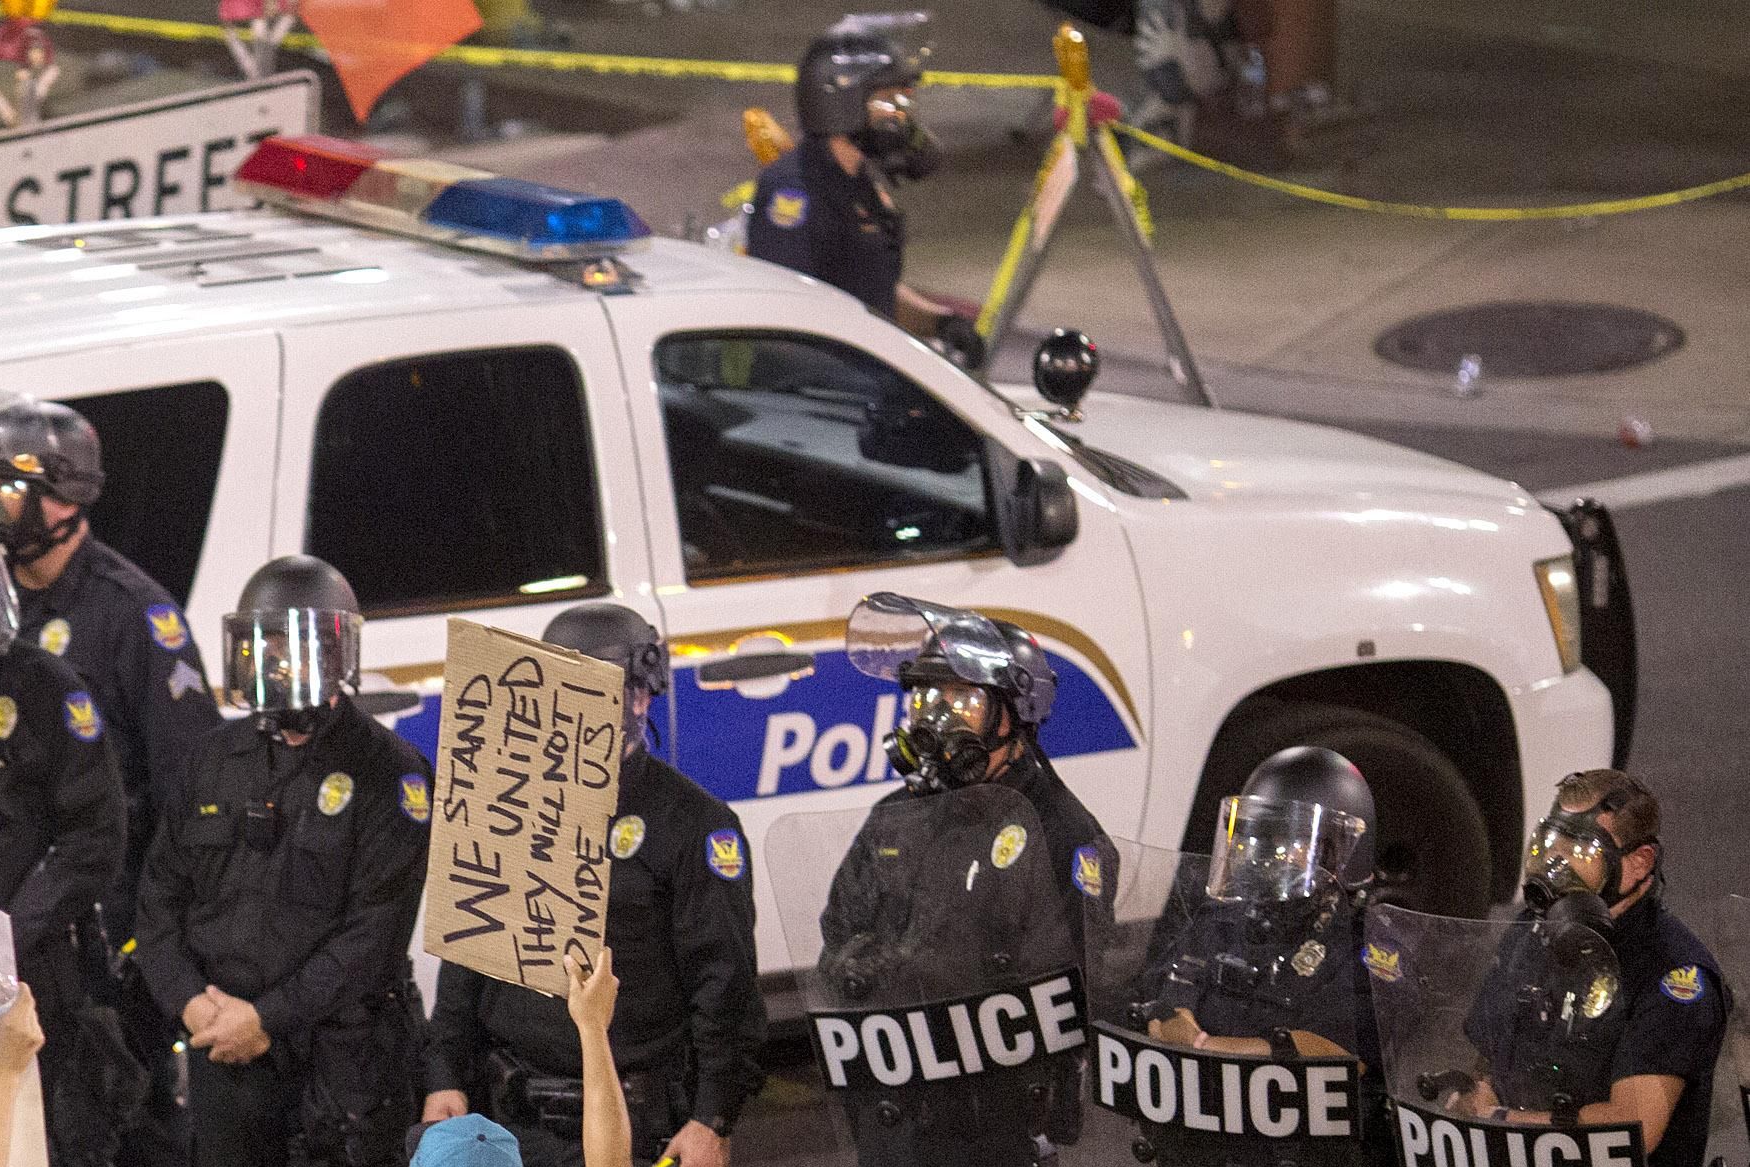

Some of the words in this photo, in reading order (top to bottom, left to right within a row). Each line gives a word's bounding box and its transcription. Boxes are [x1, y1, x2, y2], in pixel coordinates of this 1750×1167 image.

[444, 673, 493, 827] STAND
[542, 690, 574, 783] NOT
[444, 840, 510, 944] WE
[513, 869, 578, 984] THEY
[564, 825, 605, 977] DIVIDE
[815, 975, 1086, 1088] POLICE
[1098, 1034, 1350, 1138] POLICE
